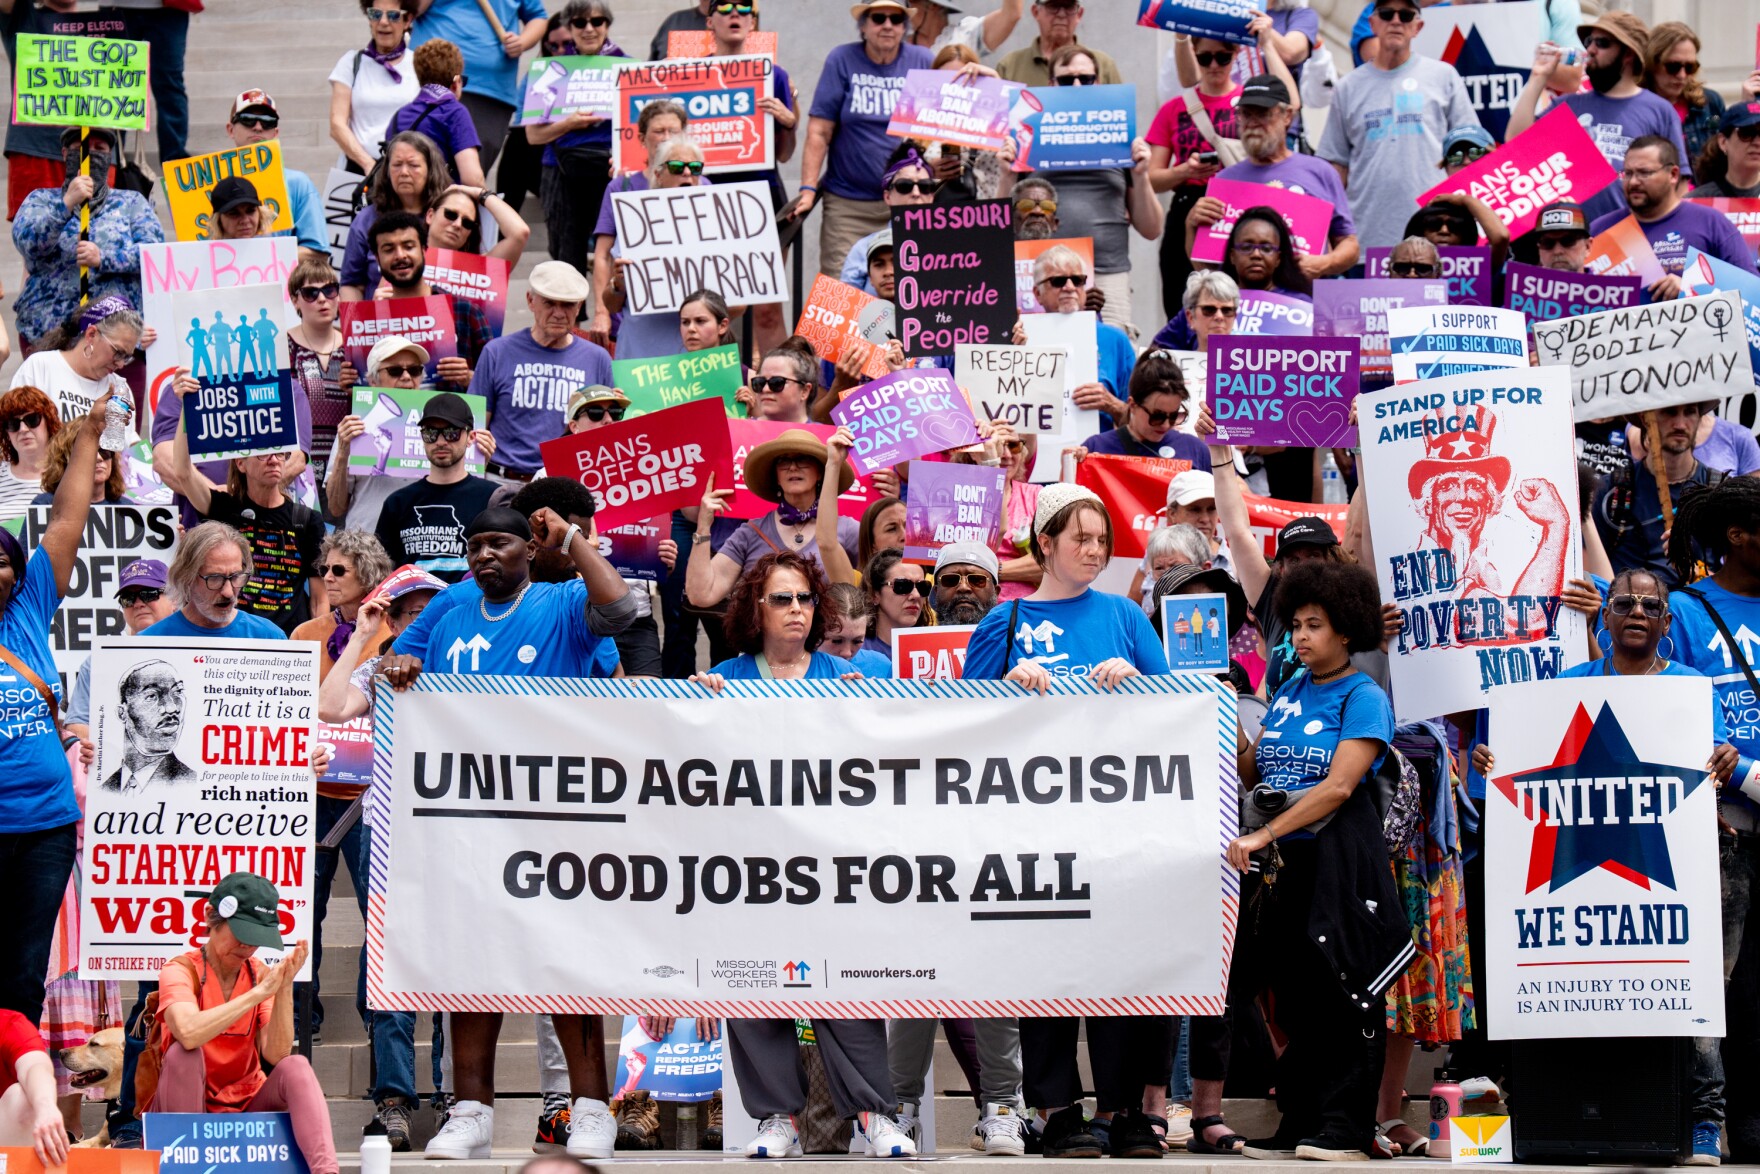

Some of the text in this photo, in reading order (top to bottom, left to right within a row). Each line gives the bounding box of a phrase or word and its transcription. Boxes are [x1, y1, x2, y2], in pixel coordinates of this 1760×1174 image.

[53, 21, 124, 32] KEEP ELECTED
[32, 40, 78, 62] THE
[27, 67, 145, 88] IS JUST NOT
[615, 58, 771, 87] MAJORITY VOTED
[689, 92, 750, 116] ON 3
[940, 83, 981, 101] DON'T
[19, 93, 113, 117] THAT INTO
[941, 98, 972, 114] BAN
[1040, 110, 1127, 124] ACT FOR
[916, 108, 988, 133] ABORTION
[1040, 123, 1128, 133] REPRODUCTIVE
[614, 128, 634, 140] TO
[714, 132, 743, 144] BAN
[1040, 132, 1128, 145] FREEDOM
[174, 145, 272, 192] UNITED
[1511, 152, 1574, 195] OUR
[614, 190, 767, 248] DEFEND
[905, 203, 1011, 231] MISSOURI
[900, 240, 982, 272] Gonna
[627, 251, 779, 312] DEMOCRACY
[816, 276, 856, 300] STOP
[899, 276, 998, 310] Override
[1512, 273, 1634, 305] I SUPPORT
[810, 289, 850, 313] STOP
[351, 315, 435, 335] DEFEND
[805, 304, 845, 328] STOP
[862, 309, 889, 339] promo
[935, 312, 952, 324] the
[1432, 314, 1497, 331] I SUPPORT
[1567, 303, 1697, 343] DEMAND
[800, 319, 839, 343] STOP
[903, 317, 989, 352] People
[1426, 335, 1522, 356] PAID SICK DAYS
[1571, 327, 1688, 367] BODILY
[514, 363, 585, 381] ABORTION
[631, 351, 739, 389] THE PEOPLE
[971, 350, 1065, 379] RESPECT
[1216, 349, 1351, 373] I SUPPORT
[660, 381, 707, 407] HAVE
[849, 376, 951, 417] SUPPORT
[997, 377, 1032, 398] MY
[1216, 374, 1343, 397] PAID SICK
[195, 386, 276, 410] JOBS WITH
[905, 394, 959, 417] SICK
[1216, 398, 1283, 421] DAYS
[1374, 387, 1542, 419] STAND UP FOR
[197, 407, 283, 440] JUSTICE
[982, 401, 1053, 430] VOTE
[852, 420, 918, 455] DAYS
[1377, 414, 1480, 444] AMERICA
[576, 434, 651, 471] BANS
[1585, 442, 1627, 456] WOMEN
[400, 459, 421, 469] KEEP
[580, 459, 634, 491] OFF
[638, 443, 705, 476] OUR
[954, 484, 987, 504] DON'T
[957, 504, 983, 524] BAN
[934, 524, 990, 545] ABORTION
[405, 541, 463, 555] FREEDOM
[1389, 548, 1457, 598] END
[1398, 595, 1563, 656] POVERTY
[223, 658, 238, 666] are
[240, 656, 291, 669] demanding
[293, 658, 312, 668] that
[1476, 646, 1564, 691] NOW
[204, 669, 312, 683] this city will respect
[204, 685, 312, 698] the dignity of labor.
[204, 699, 311, 719] That it is a
[201, 724, 309, 767] CRIME
[200, 771, 309, 783] for people to live in this
[413, 752, 1194, 807] UNITED AGAINST RACISM
[201, 785, 309, 803] rich nation
[1514, 776, 1685, 827] UNITED
[94, 802, 308, 837] and receive
[91, 843, 306, 887] STARVATION
[503, 850, 1090, 914] GOOD JOBS FOR ALL
[1515, 904, 1689, 948] WE STAND
[88, 957, 102, 970] ON
[105, 957, 144, 970] STRIKE
[711, 970, 777, 978] WORKERS
[716, 960, 777, 969] MISSOURI
[841, 966, 936, 980] moworkers.org
[727, 980, 778, 988] CENTER
[1517, 978, 1691, 995] AN INJURY TO ONE
[1517, 997, 1692, 1014] IS AN INJURY TO ALL
[657, 1042, 707, 1055] ACT
[192, 1120, 276, 1139] I SUPPORT
[164, 1144, 289, 1164] PAID SICK DAYS
[1459, 1147, 1501, 1157] SUBWAY
